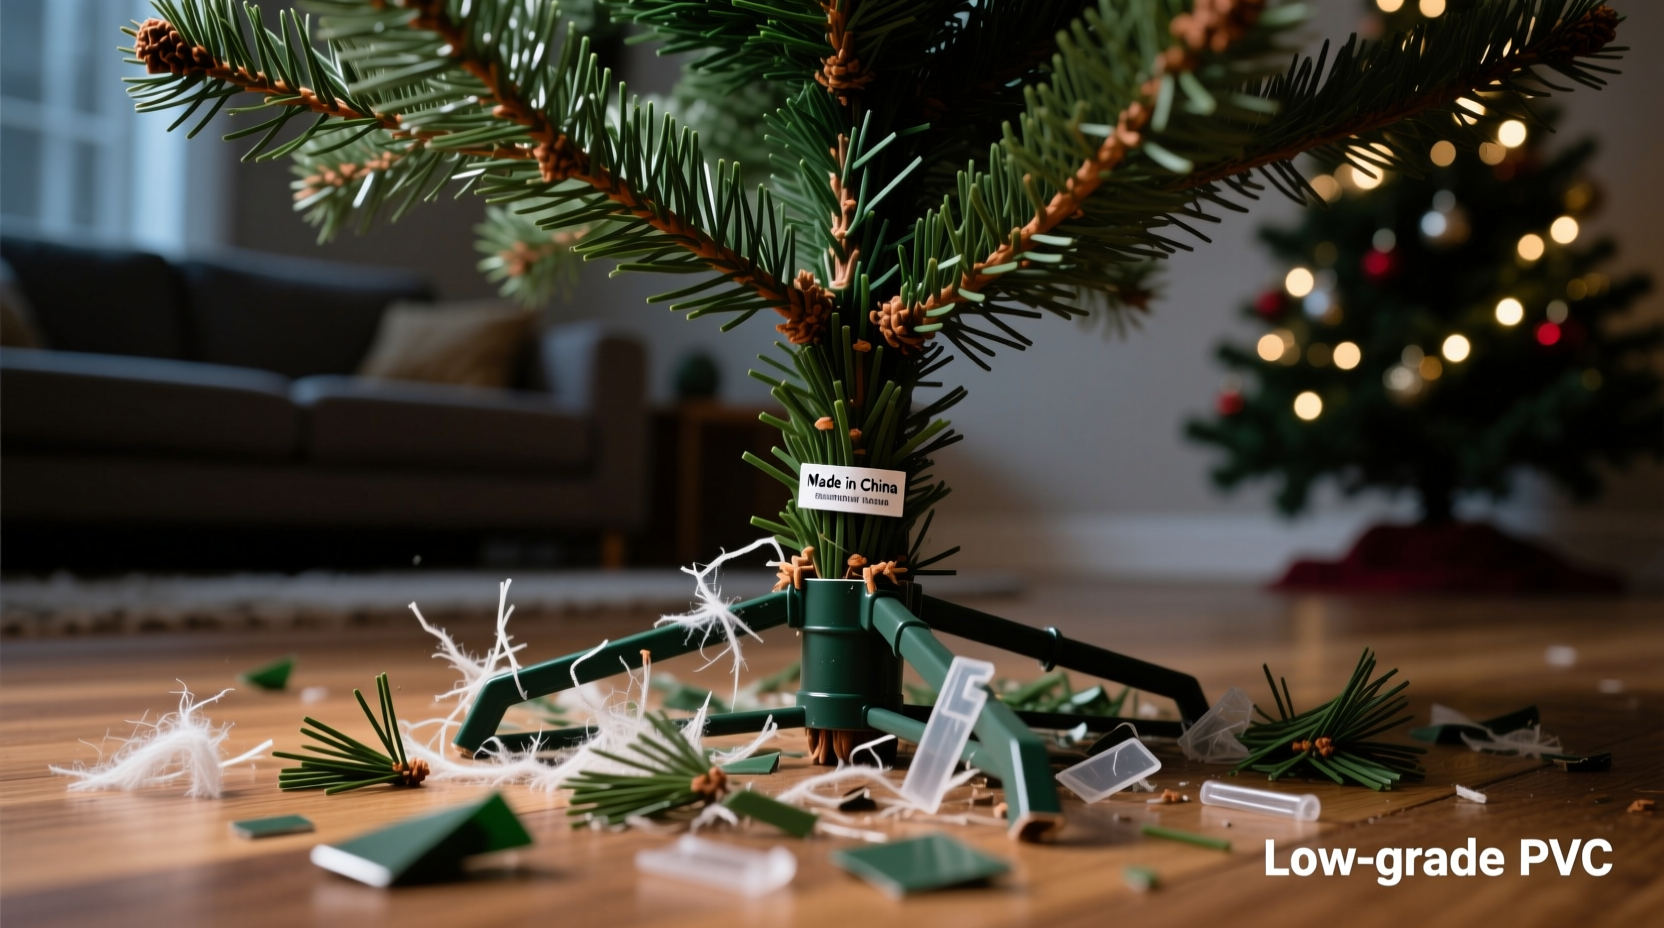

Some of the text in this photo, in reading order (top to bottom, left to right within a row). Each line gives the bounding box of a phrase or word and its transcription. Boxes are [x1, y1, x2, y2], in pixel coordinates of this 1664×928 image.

[807, 473, 898, 494] Made in China
